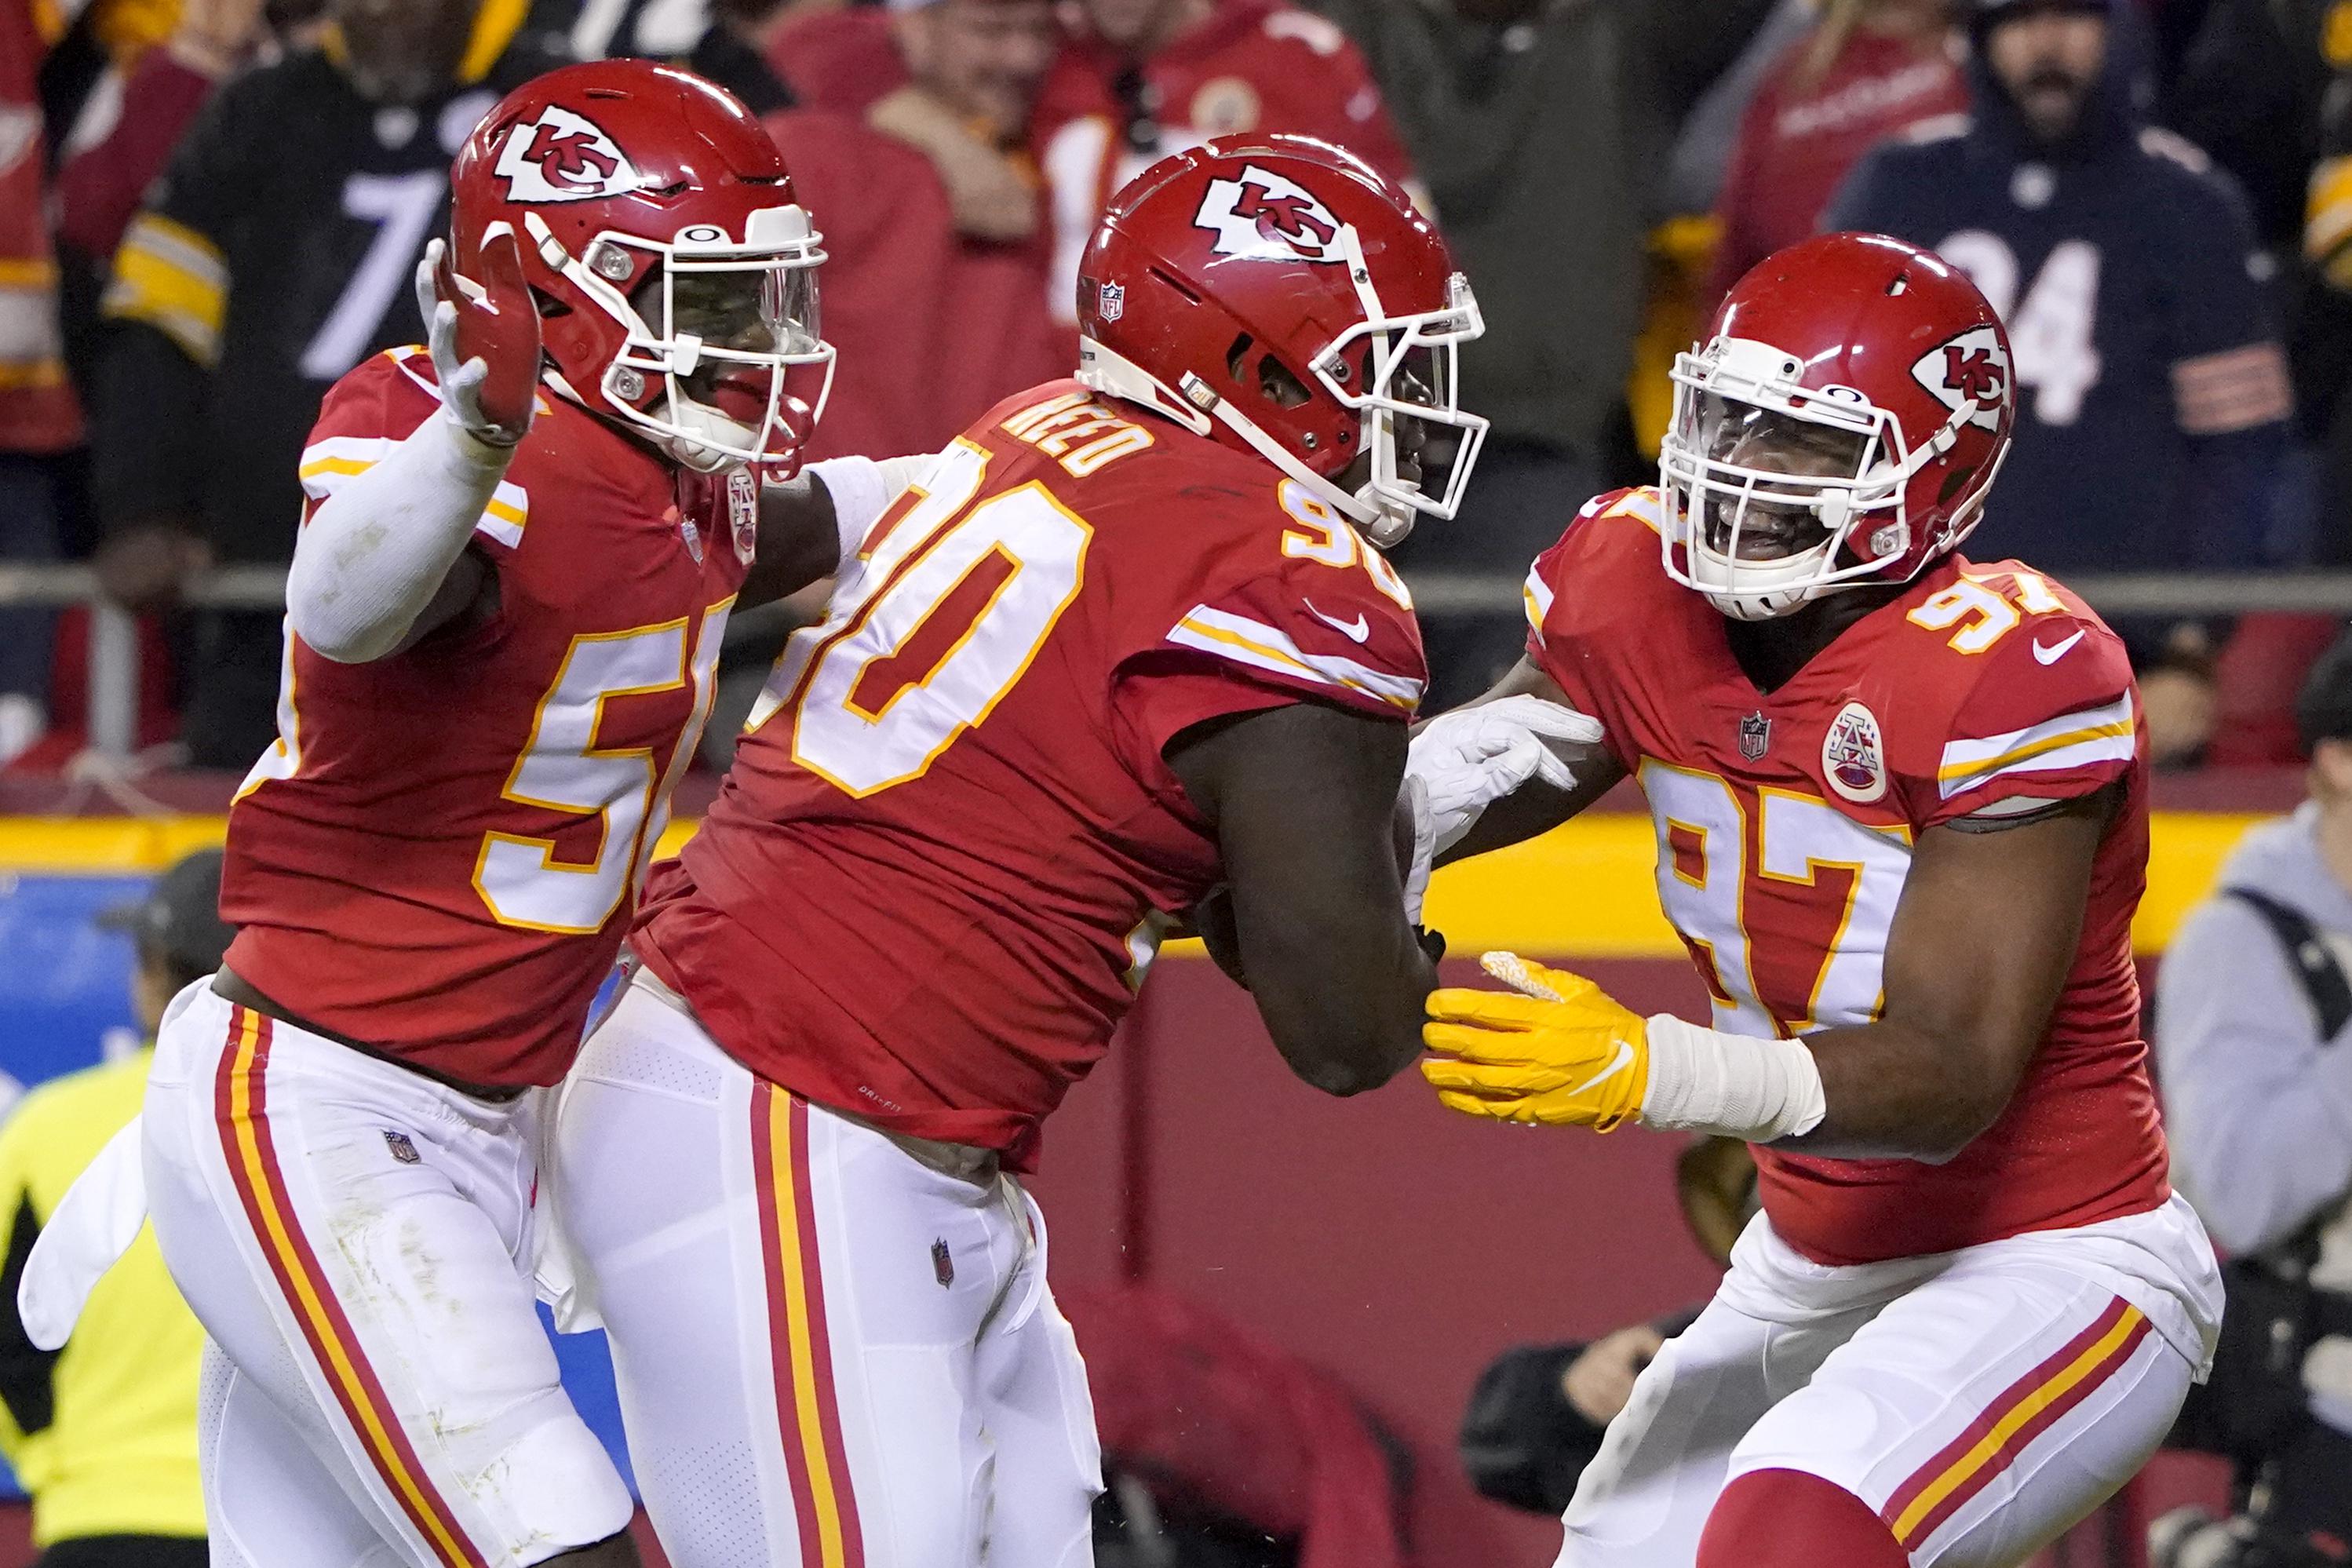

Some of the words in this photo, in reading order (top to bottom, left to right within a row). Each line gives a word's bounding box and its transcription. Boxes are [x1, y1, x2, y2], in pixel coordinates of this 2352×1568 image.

[522, 123, 619, 195] KC
[1230, 181, 1336, 257] KC
[298, 169, 447, 378] 7
[1101, 300, 1119, 315] NFL
[1942, 345, 2004, 411] KC
[1000, 392, 1155, 478] REED
[744, 436, 1095, 800] 90
[1636, 754, 1913, 1040] 97
